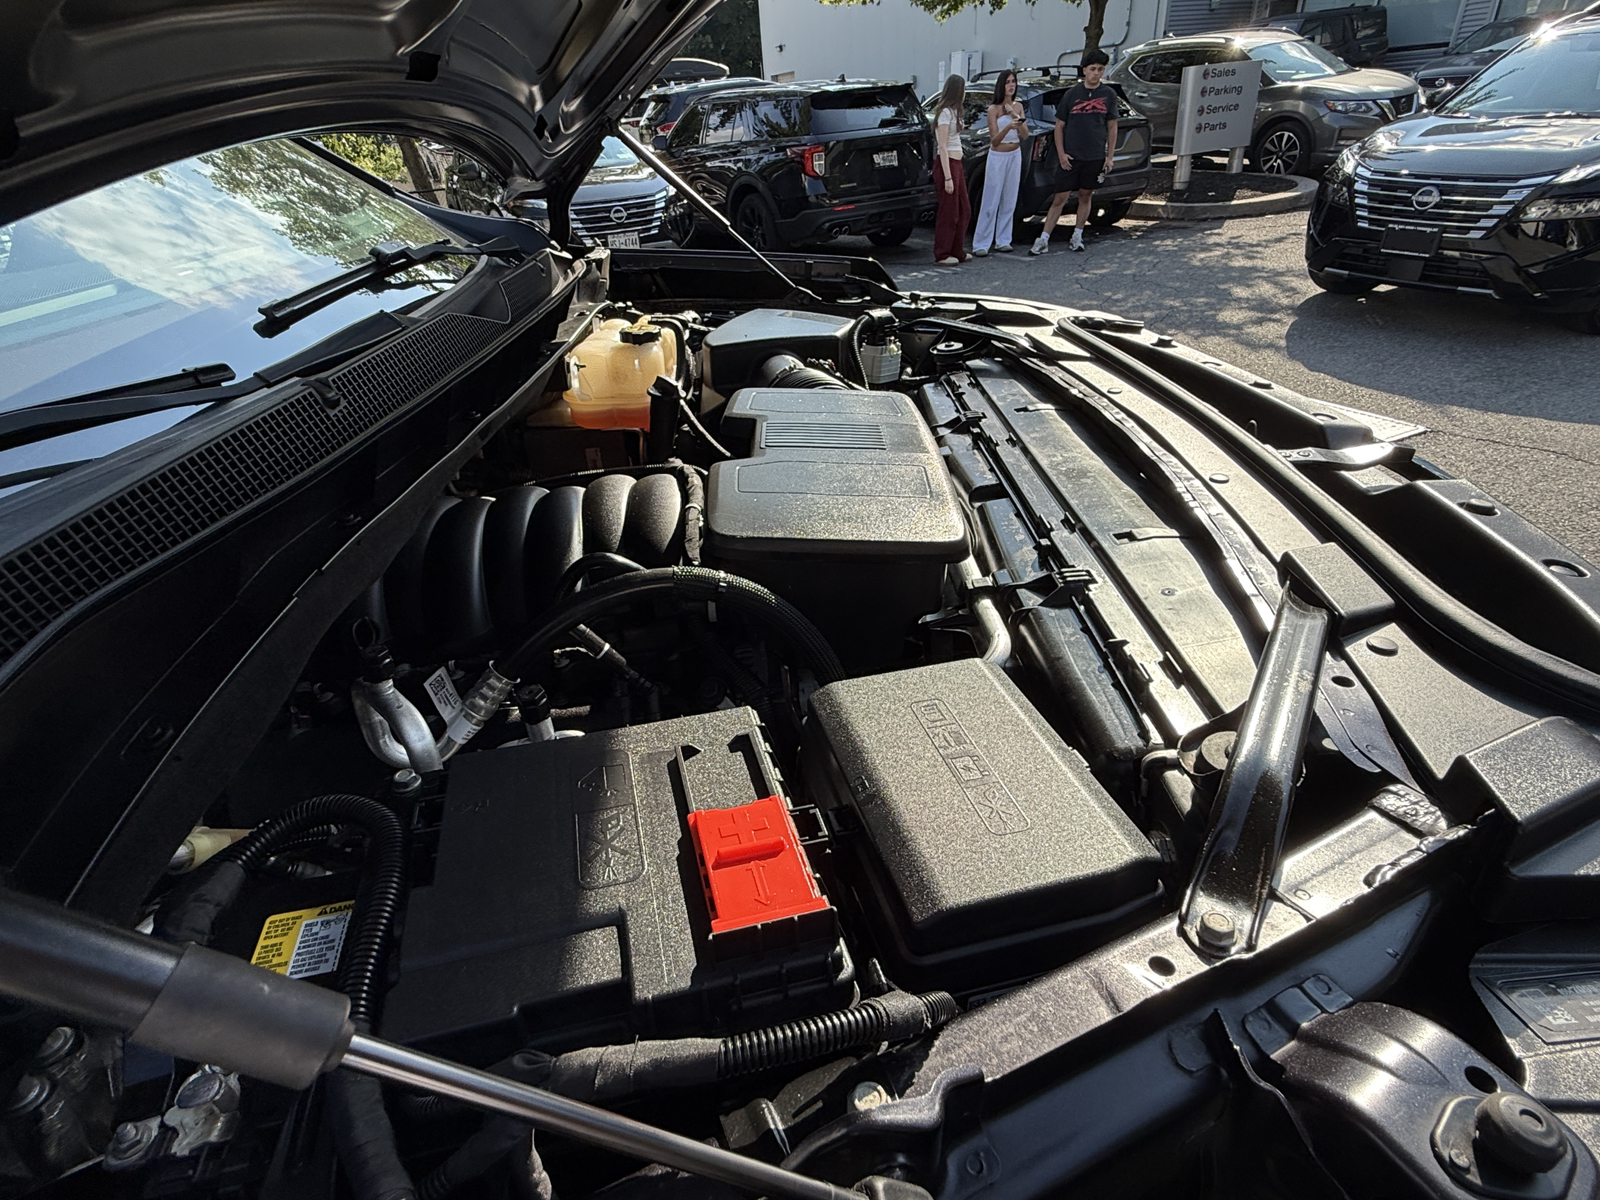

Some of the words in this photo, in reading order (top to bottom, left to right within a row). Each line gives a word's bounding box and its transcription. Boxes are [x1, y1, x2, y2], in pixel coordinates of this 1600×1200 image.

[1210, 68, 1236, 78] Sales
[1208, 85, 1243, 96] Parking
[1206, 103, 1240, 114] Service
[1203, 122, 1227, 132] Parts
